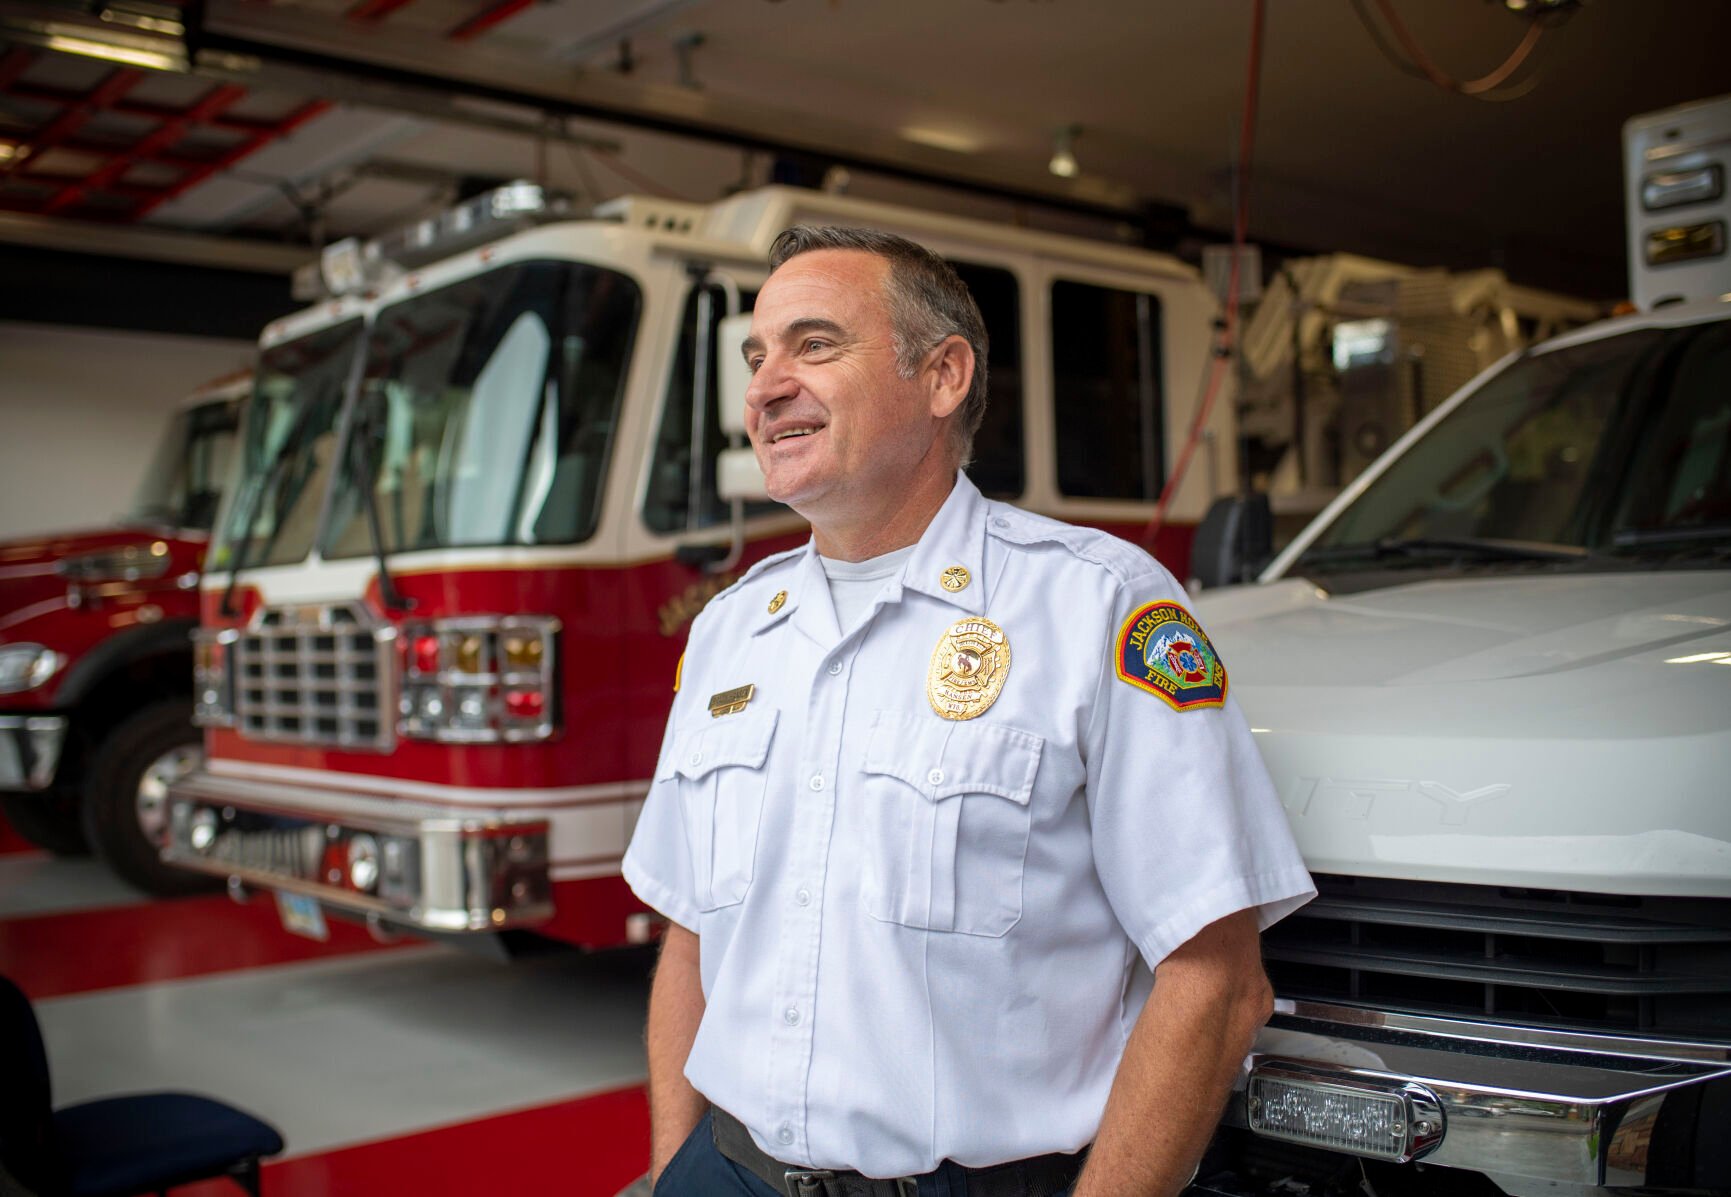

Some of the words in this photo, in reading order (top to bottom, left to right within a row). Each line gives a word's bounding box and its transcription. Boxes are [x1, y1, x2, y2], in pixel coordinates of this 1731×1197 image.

[956, 623, 998, 639] CHIEF
[1130, 608, 1178, 650] JACKSON
[1180, 611, 1208, 644] HOLE
[1145, 669, 1178, 695] FIRE
